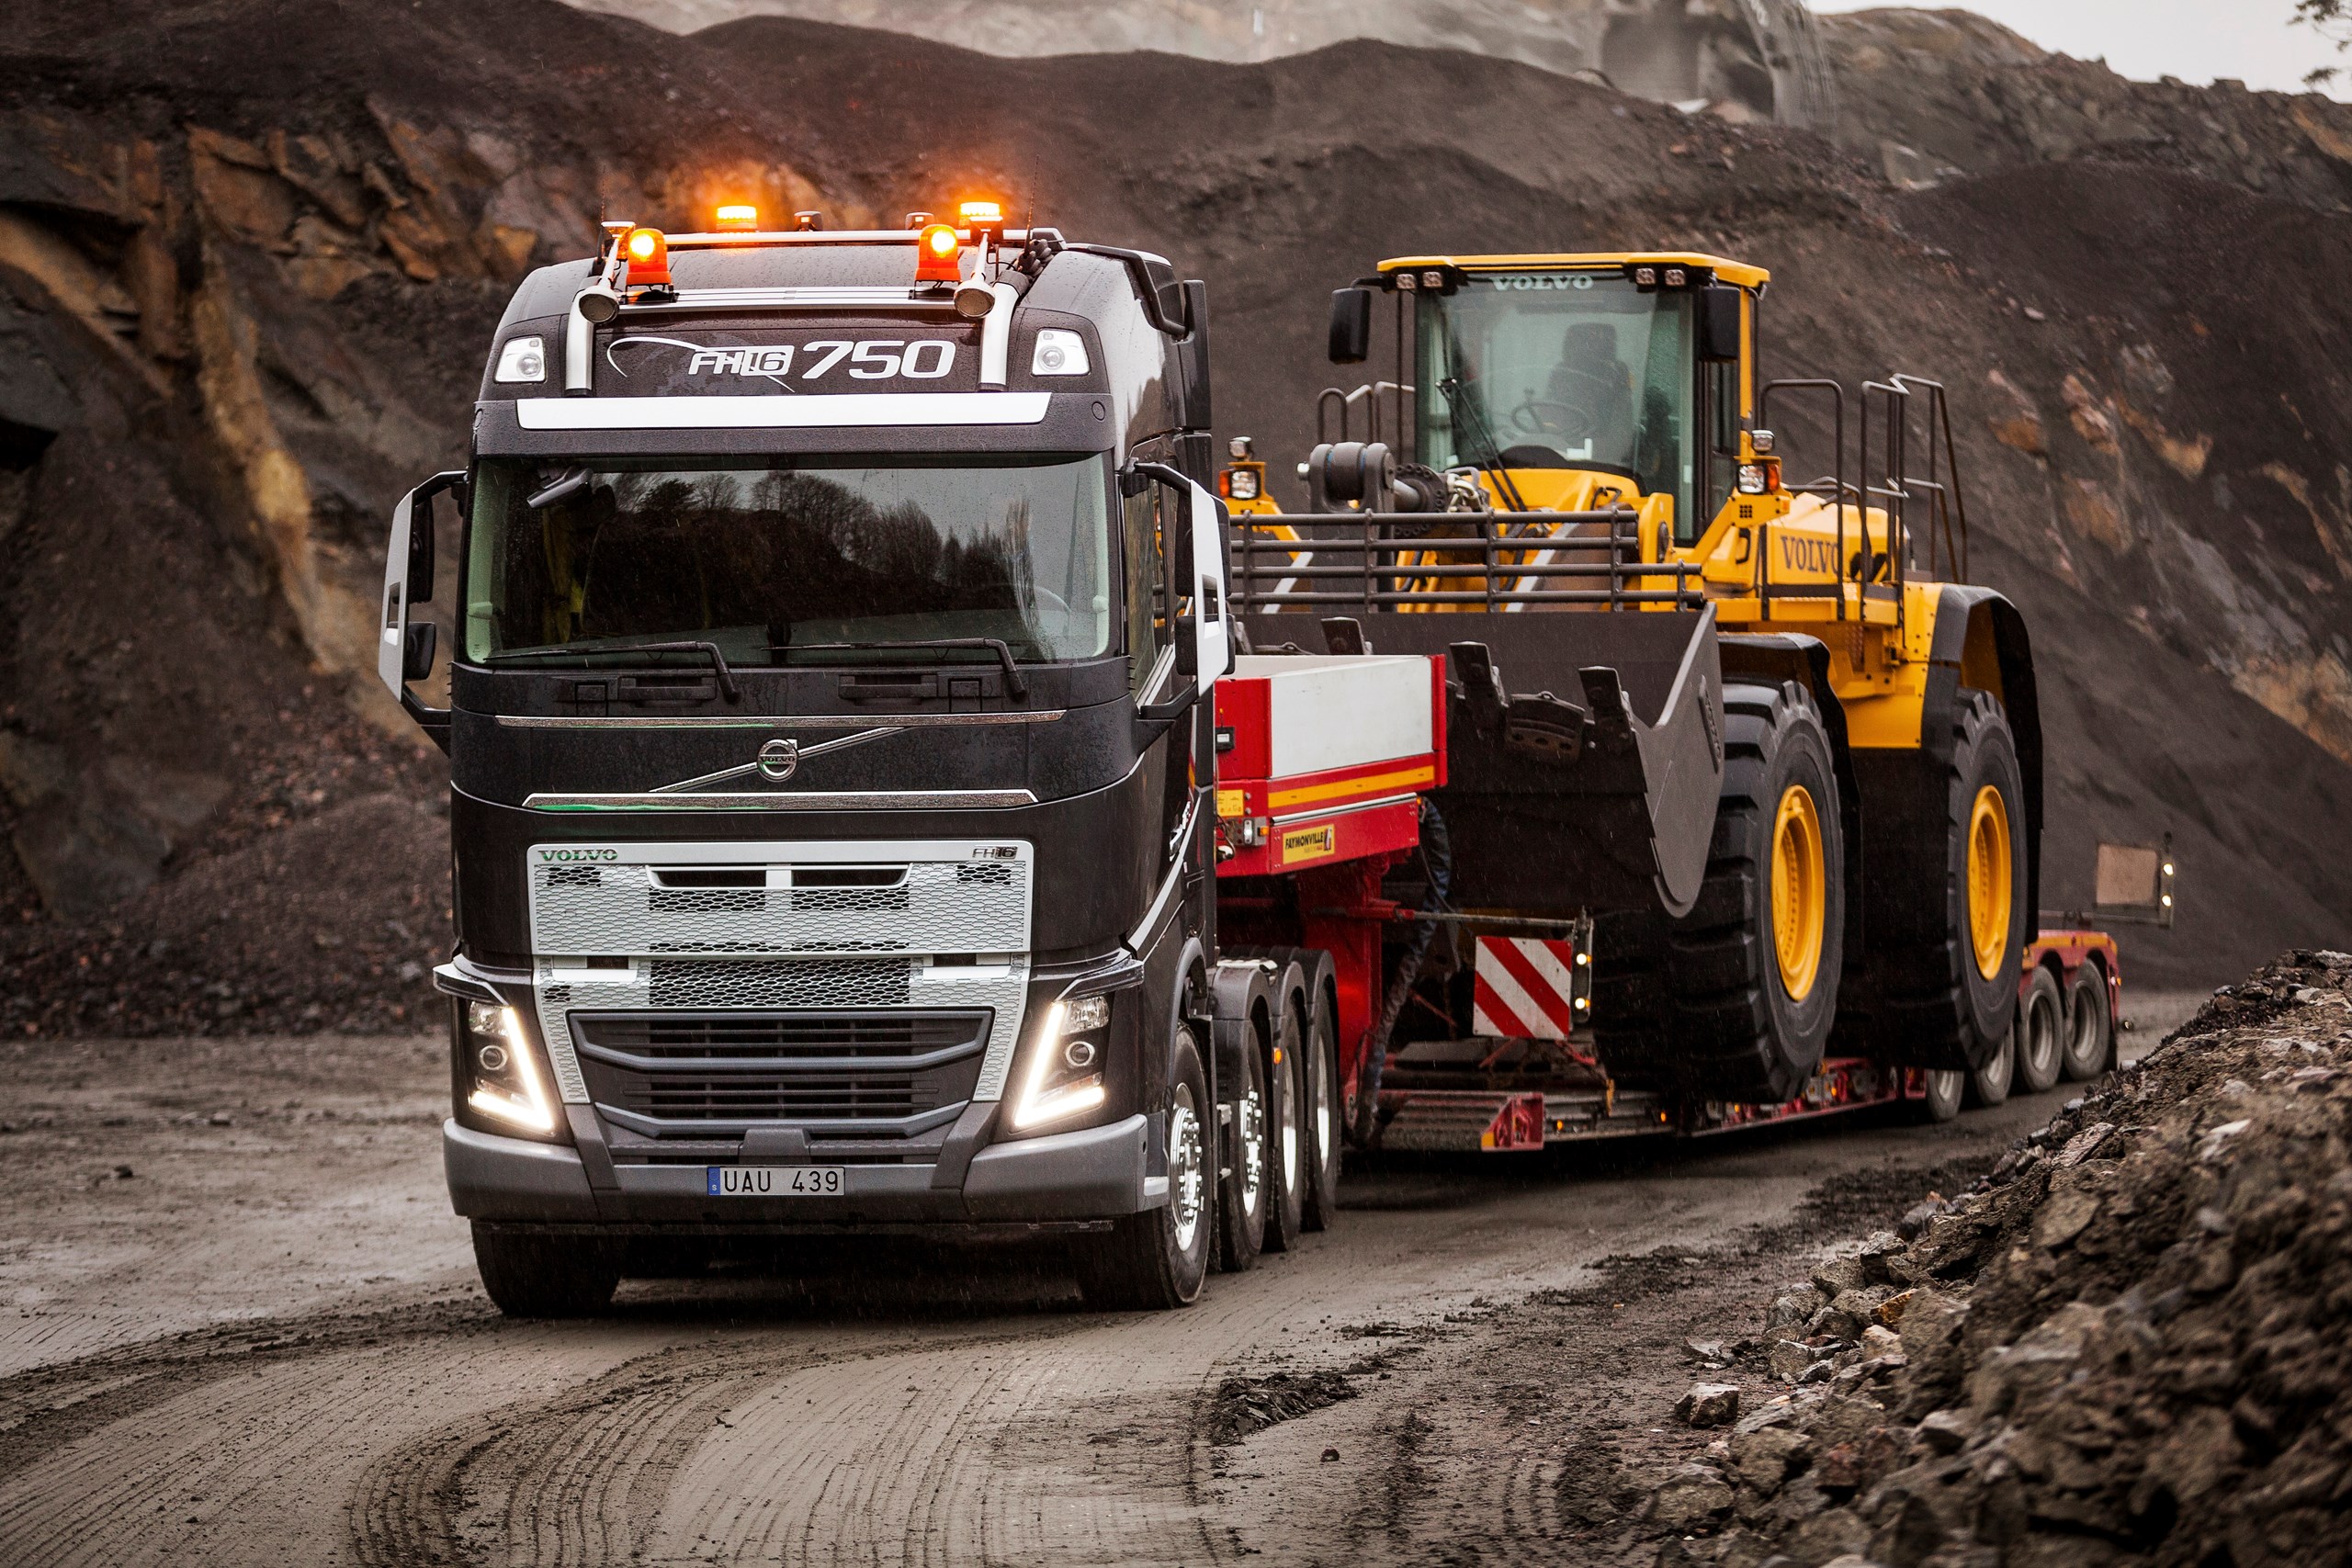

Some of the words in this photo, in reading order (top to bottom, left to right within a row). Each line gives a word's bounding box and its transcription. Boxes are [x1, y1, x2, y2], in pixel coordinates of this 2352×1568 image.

[1489, 275, 1594, 291] VOLVO
[688, 345, 796, 376] FH16
[802, 340, 956, 379] 750
[1285, 831, 1323, 850] FAYMONVILLE
[537, 849, 618, 862] VOLVO
[972, 846, 1018, 860] FH16
[724, 1170, 771, 1192] UAU
[792, 1170, 838, 1192] 439
